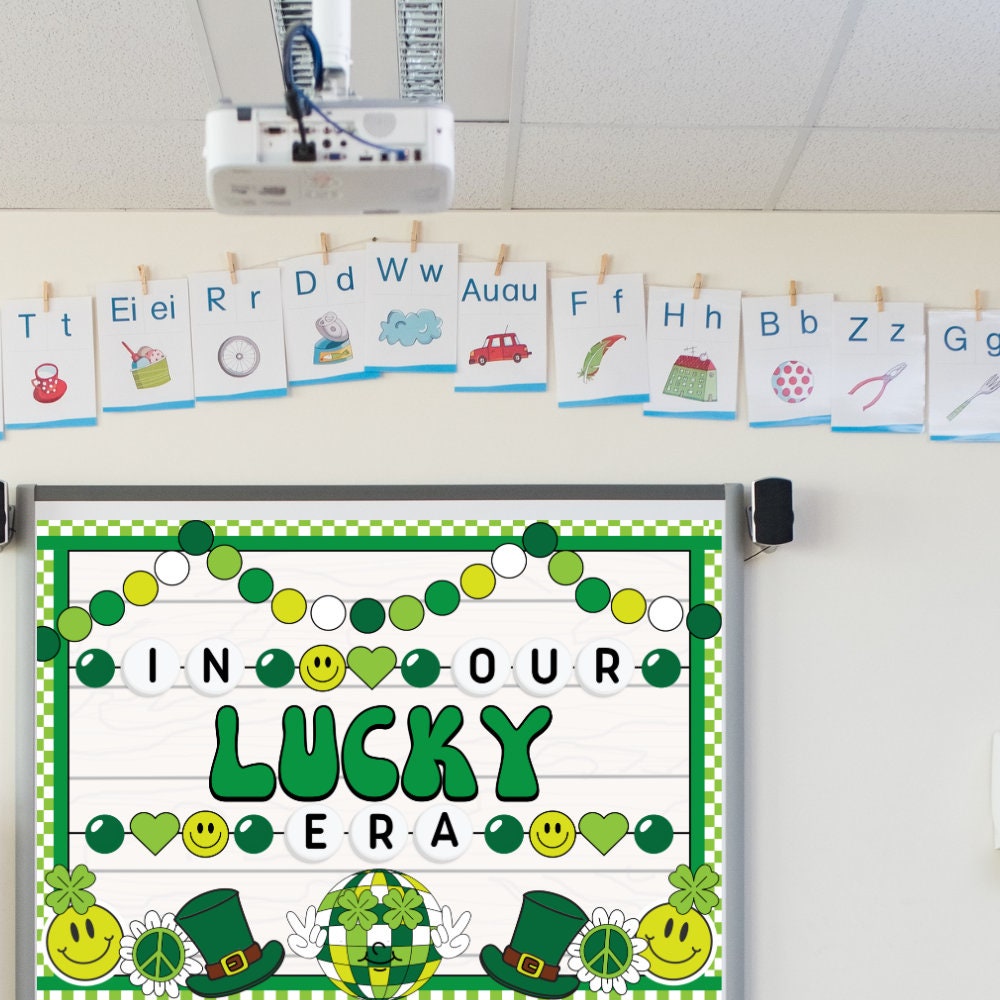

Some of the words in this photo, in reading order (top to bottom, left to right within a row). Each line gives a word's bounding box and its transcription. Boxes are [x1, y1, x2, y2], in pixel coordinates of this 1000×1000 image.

[296, 270, 318, 296] D
[336, 265, 355, 292] d
[376, 256, 409, 283] W
[420, 262, 444, 283] w
[111, 295, 137, 323] Ei
[150, 294, 176, 321] ei
[207, 286, 226, 312] R
[250, 289, 261, 309] r
[571, 290, 588, 316] F
[612, 288, 624, 314] f
[17, 313, 37, 339] T
[60, 313, 72, 337] t
[663, 301, 685, 328] H
[705, 304, 722, 330] h
[760, 311, 780, 337] B
[799, 308, 819, 335] b
[848, 316, 869, 342] Z
[890, 323, 905, 342] z
[943, 325, 967, 352] G
[986, 332, 1000, 358] g
[148, 646, 230, 684] IN
[468, 646, 621, 685] OUR
[208, 704, 554, 803] LUCKY
[304, 812, 459, 850] ERA
